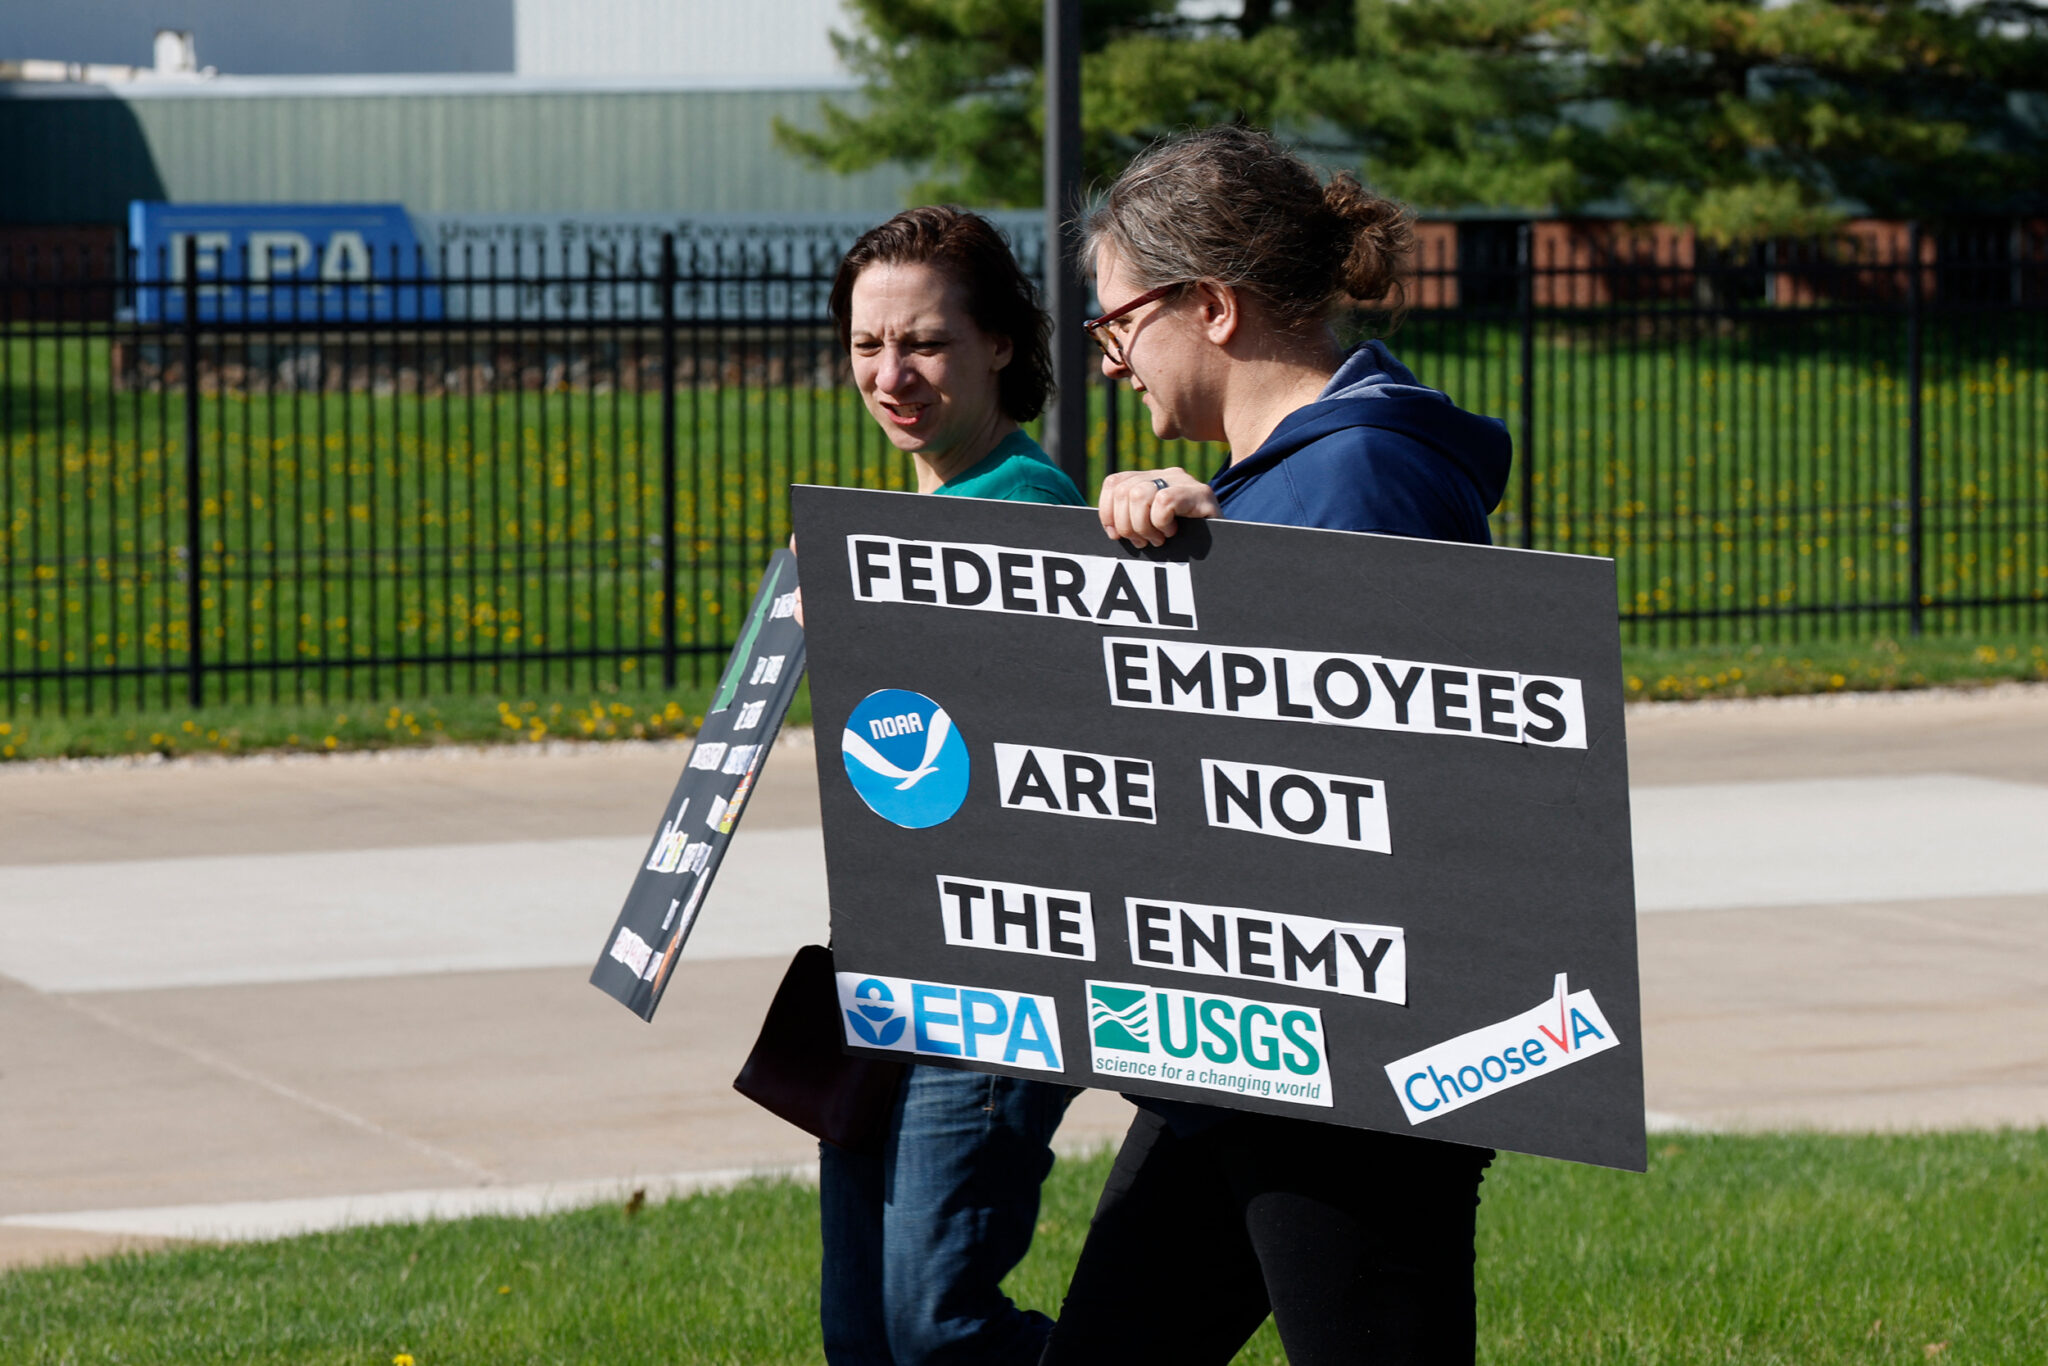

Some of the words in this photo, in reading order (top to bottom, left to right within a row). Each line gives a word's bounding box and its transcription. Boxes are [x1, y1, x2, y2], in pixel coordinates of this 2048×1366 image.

[169, 231, 385, 296] EPA
[855, 540, 1194, 629] FEDERAL
[869, 712, 924, 740] NOAA
[1112, 642, 1567, 742] EMPLOYEES
[1007, 749, 1154, 820] ARE
[1213, 764, 1374, 841] NOT
[943, 881, 1085, 957] THE
[1136, 904, 1393, 993] ENEMY
[911, 983, 1061, 1069] EPA
[1156, 993, 1320, 1075] USGS
[1096, 1056, 1156, 1076] science
[1161, 1063, 1182, 1080] for
[1186, 1070, 1195, 1081] a
[1200, 1069, 1270, 1096] changing
[1275, 1081, 1321, 1099] world
